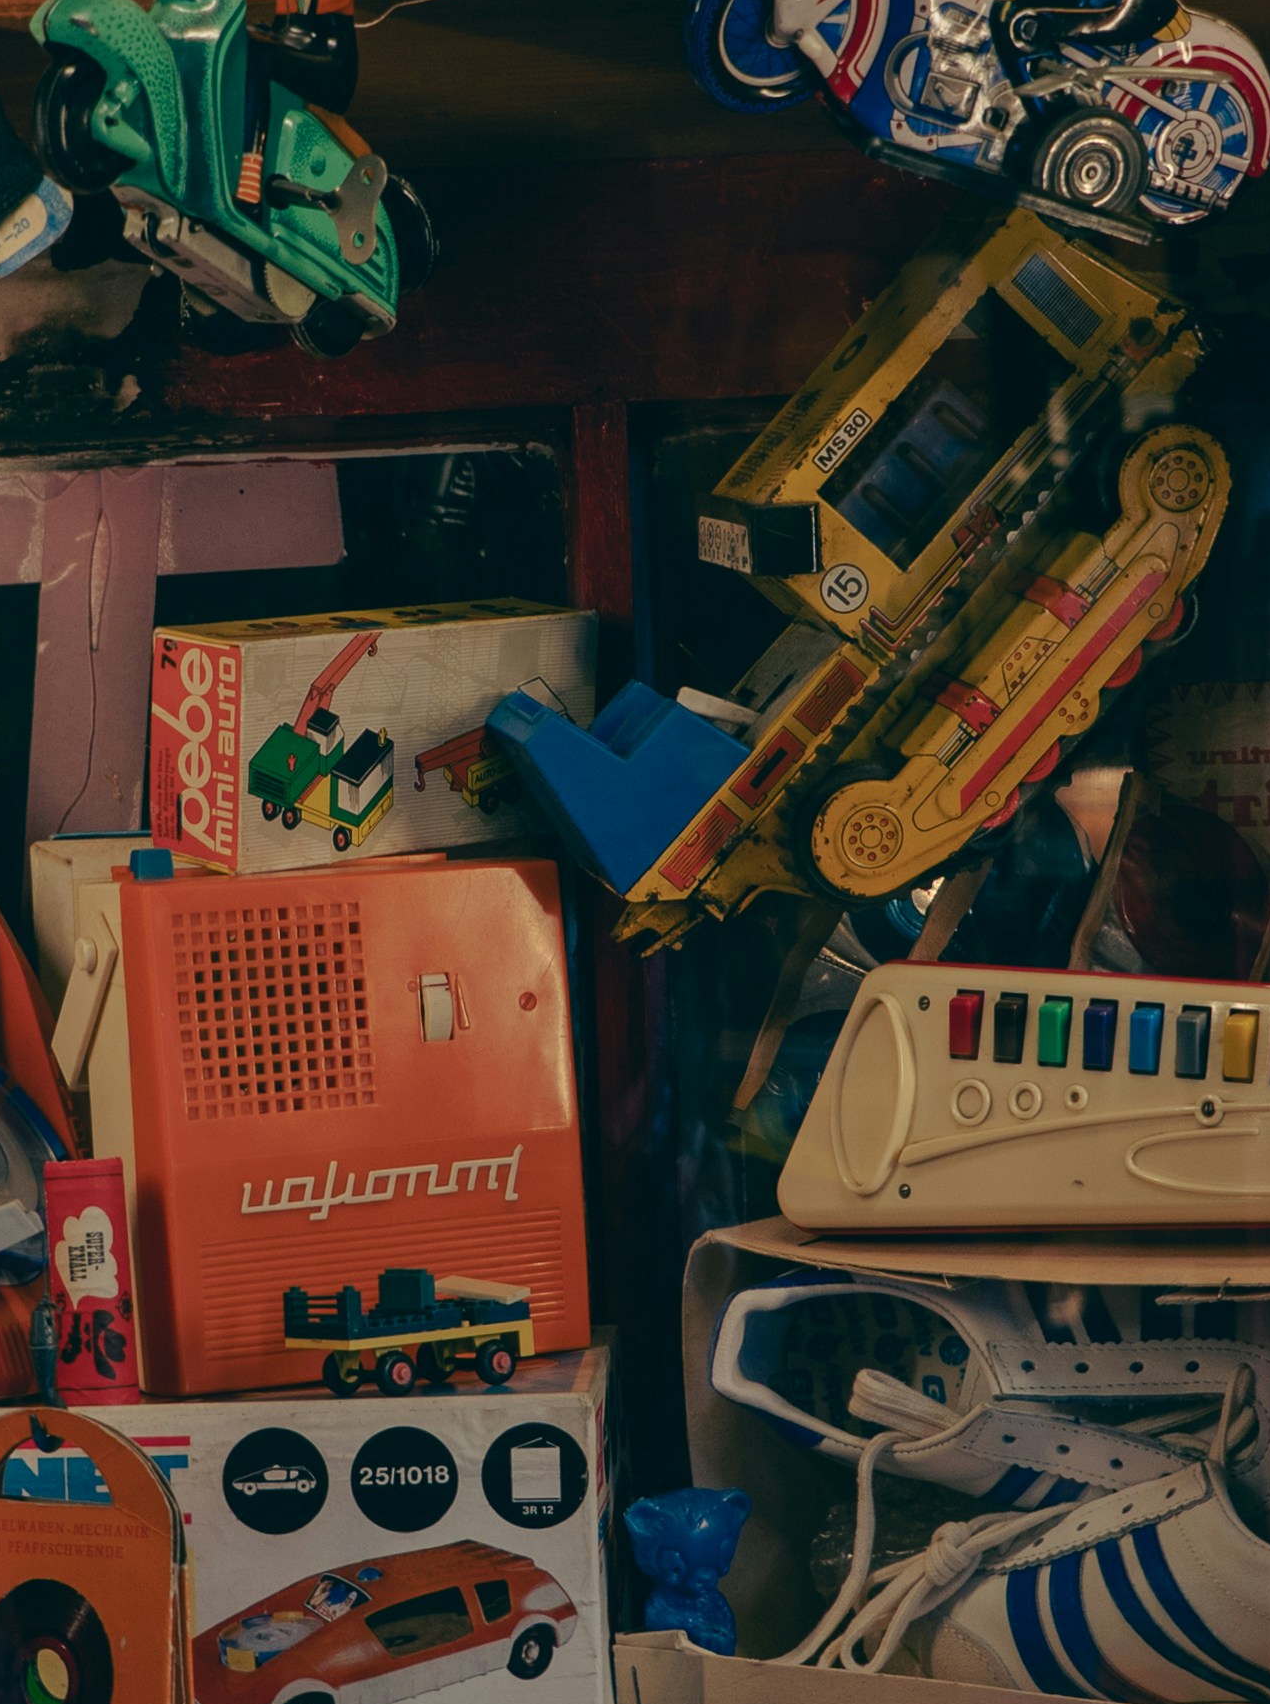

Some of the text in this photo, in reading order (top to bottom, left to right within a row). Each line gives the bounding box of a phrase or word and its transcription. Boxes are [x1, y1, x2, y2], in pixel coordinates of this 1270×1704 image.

[816, 413, 867, 468] MS 80
[826, 568, 863, 607] 15
[150, 647, 217, 853] pebe
[68, 1245, 87, 1282] KNALL
[86, 1231, 105, 1271] SUPER-
[359, 1465, 451, 1486] 25/1018
[521, 1504, 555, 1516] 3R 12
[8, 1541, 125, 1560] PFAFFSCHWENDE
